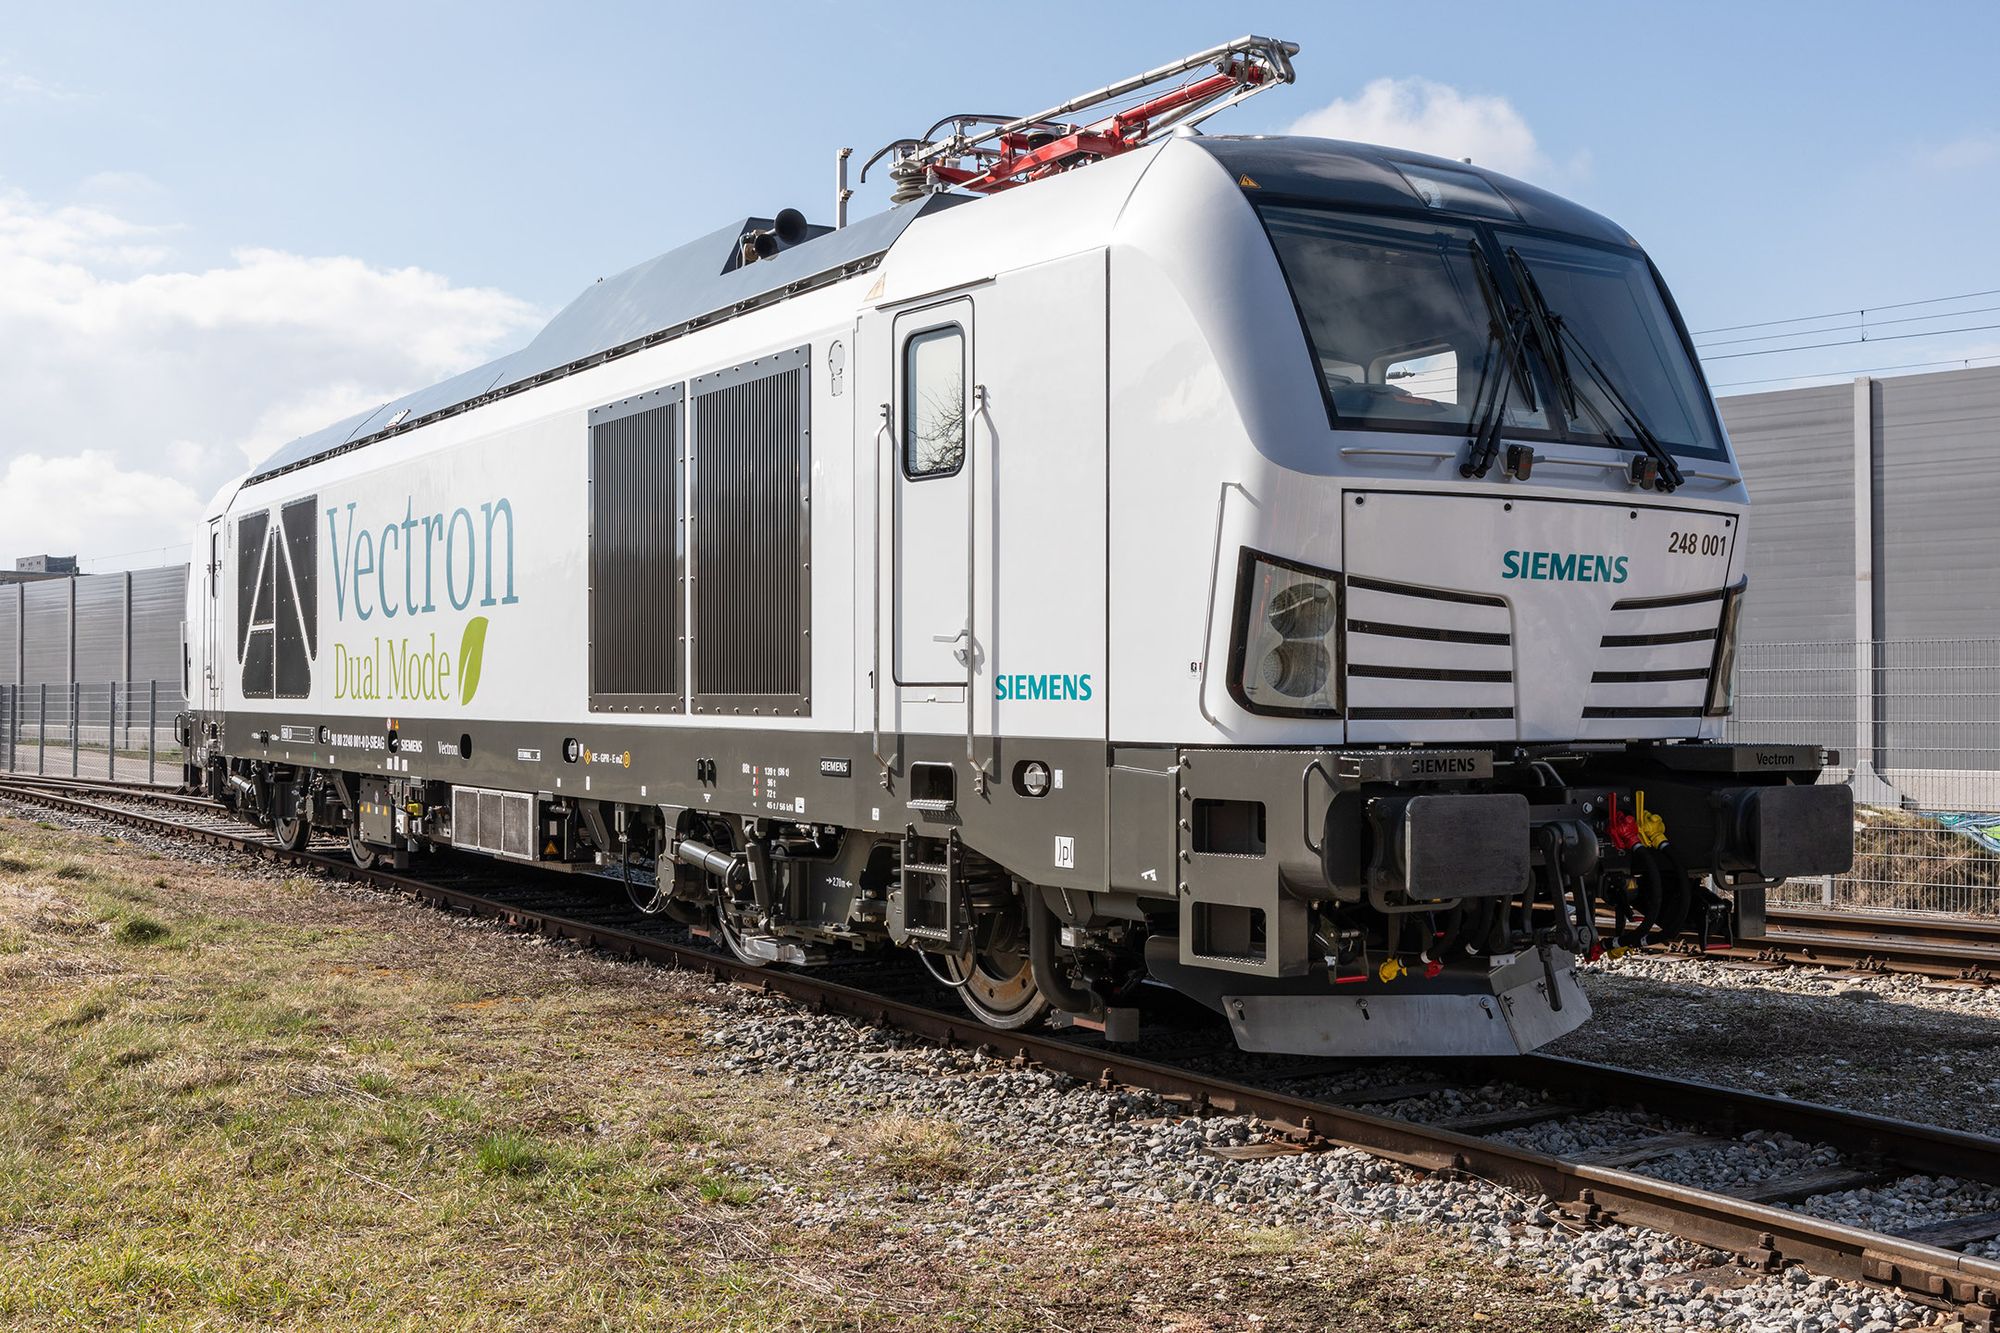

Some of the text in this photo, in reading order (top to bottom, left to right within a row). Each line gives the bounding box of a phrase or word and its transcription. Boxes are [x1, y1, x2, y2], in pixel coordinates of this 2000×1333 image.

[1669, 531, 1726, 557] 248 001
[326, 495, 519, 622] Vectron
[1502, 550, 1629, 584] SIEMENS
[334, 632, 450, 701] Dual Mode
[995, 674, 1092, 701] SIEMENS
[400, 739, 422, 752] SIEMENS
[438, 741, 458, 756] Vectron
[820, 761, 847, 772] SIEMENS
[1411, 757, 1476, 775] SIEMENS
[1755, 752, 1794, 766] Vectron
